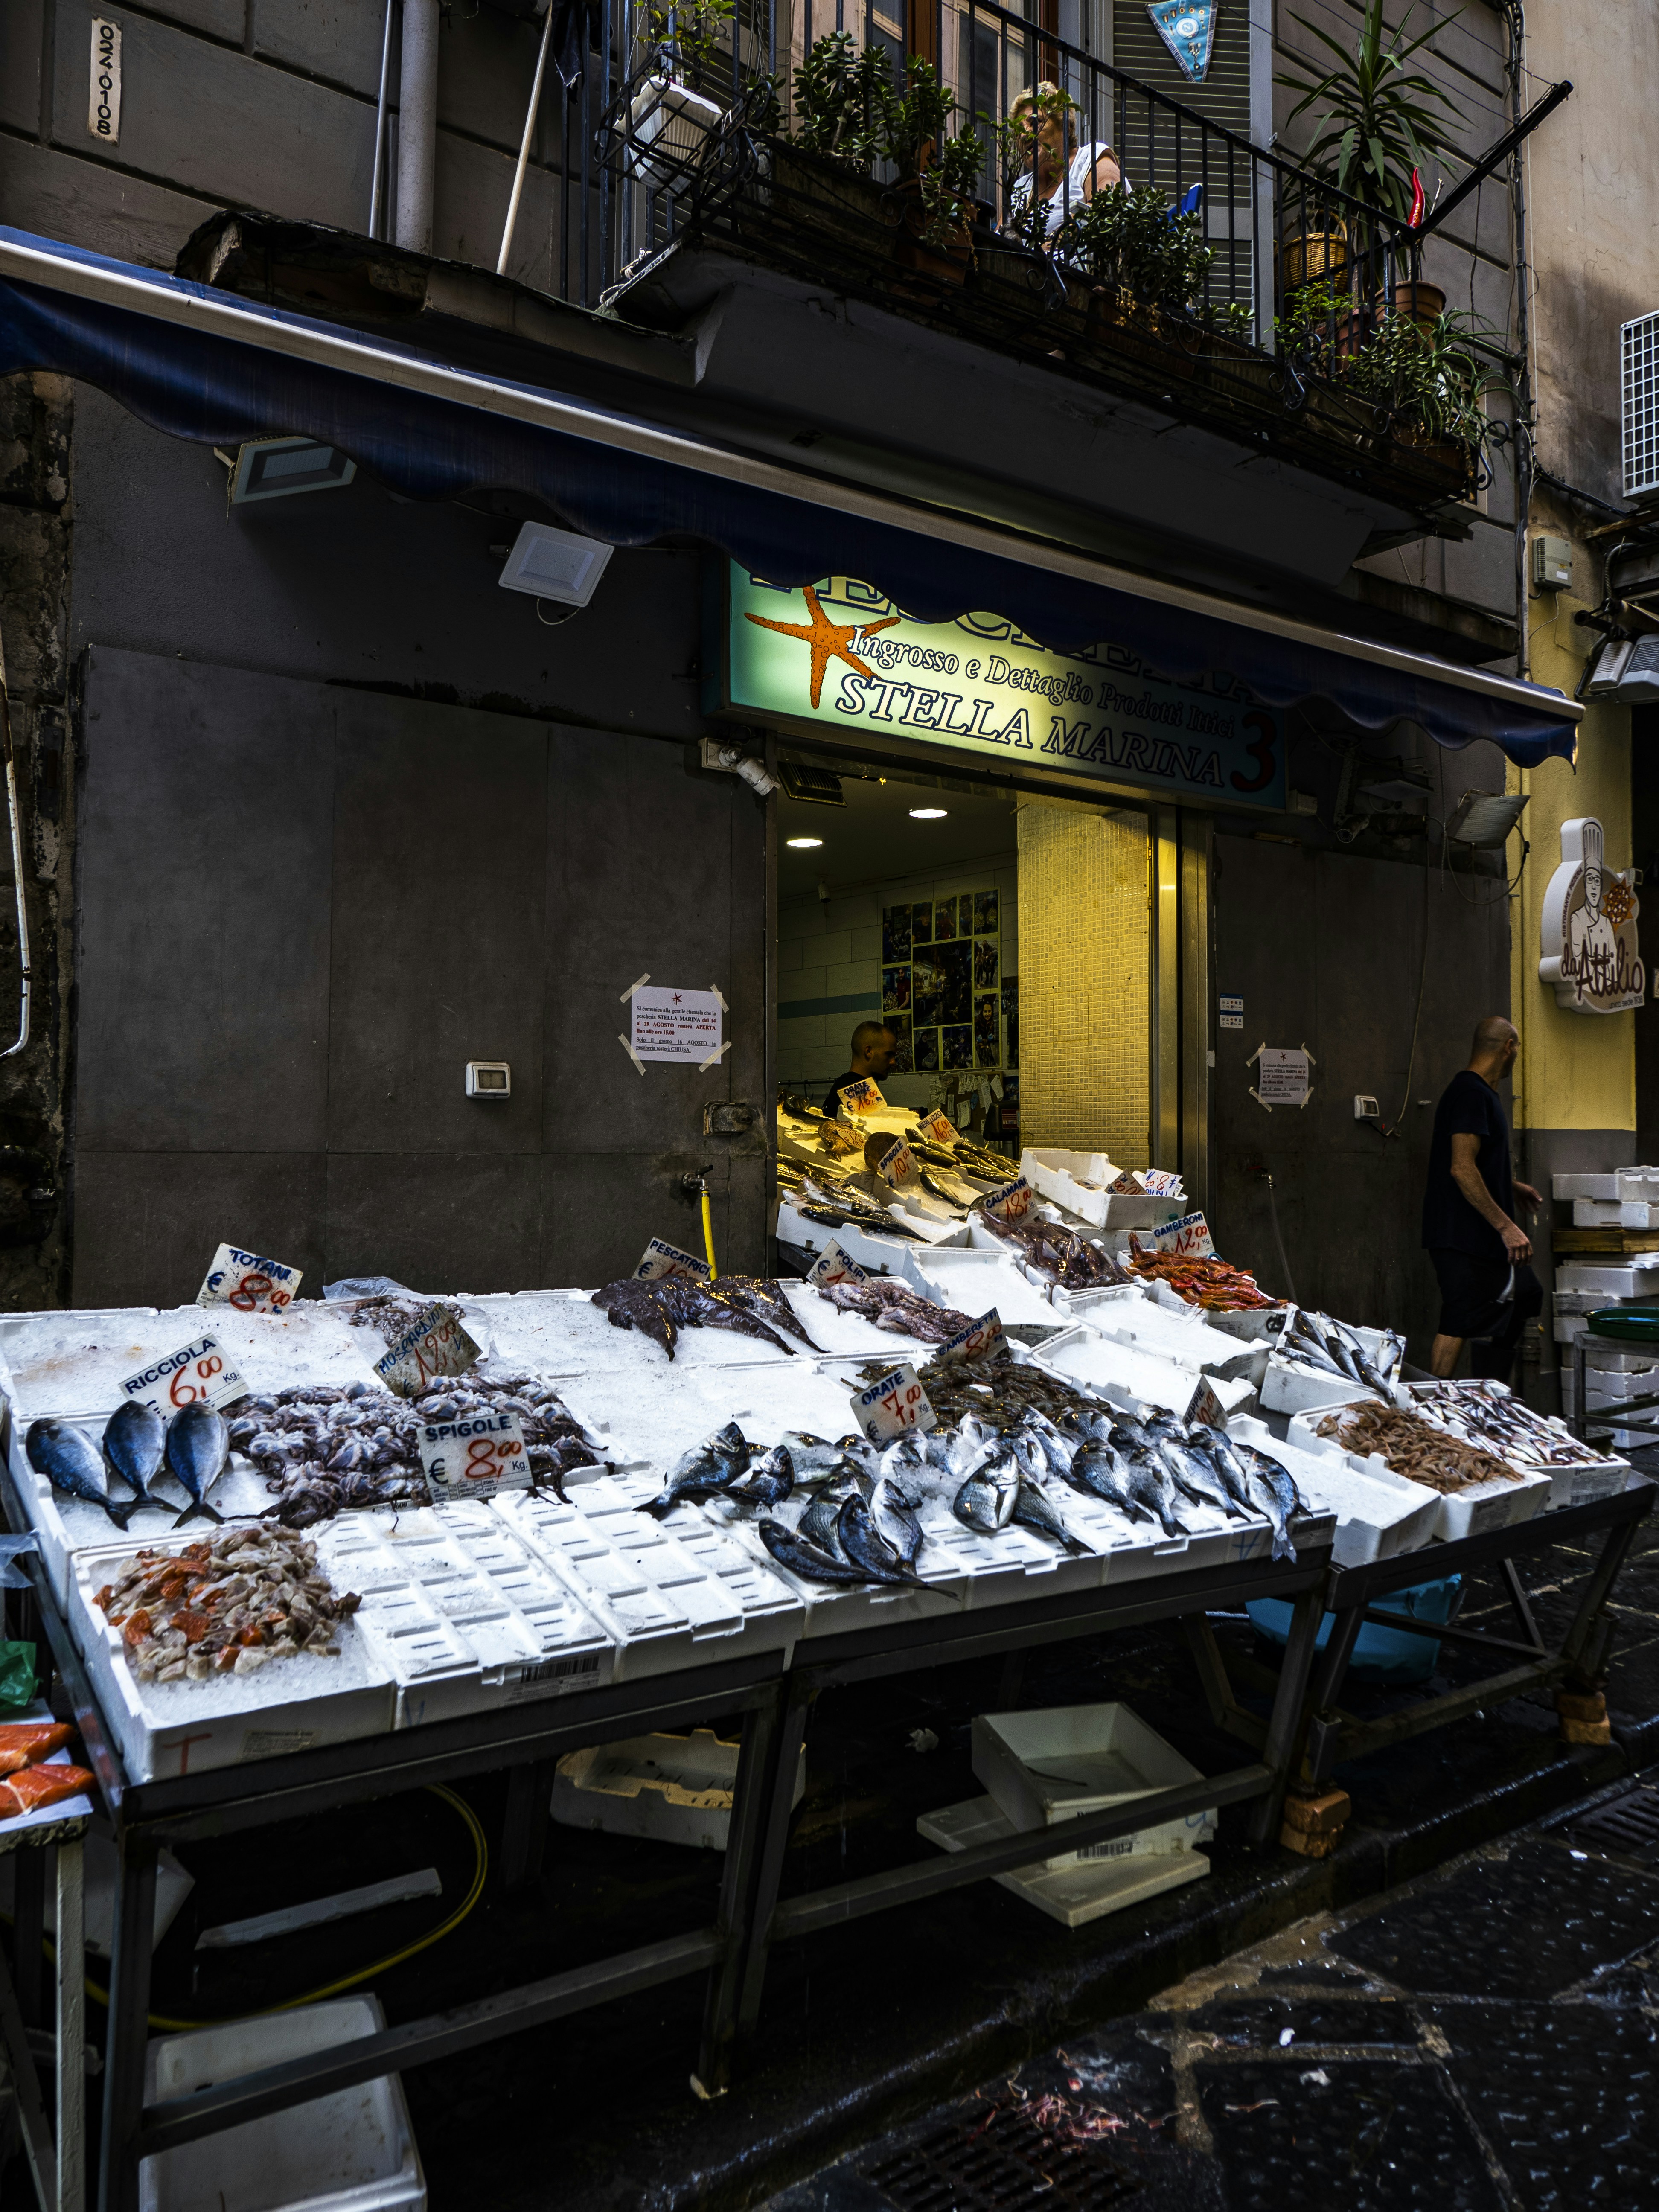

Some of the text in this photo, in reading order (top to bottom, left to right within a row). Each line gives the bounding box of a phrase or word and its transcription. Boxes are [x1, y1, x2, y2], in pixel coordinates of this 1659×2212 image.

[848, 625, 1234, 739] Ingrosso e Dettaglio Prodotti Ittici
[835, 673, 1276, 792] STELLA MARINA 3
[1562, 891, 1571, 937] RISTORANTE
[1576, 937, 1643, 1001] Attilio
[844, 1081, 867, 1094] ORATE
[917, 1111, 942, 1130] MERLUZZO
[880, 1141, 903, 1170] SPIGOLE
[986, 1177, 1027, 1208] CALAMARI
[1154, 1213, 1203, 1237] GAMBERONI
[229, 1248, 291, 1280] TOTANI
[650, 1240, 710, 1275] PESCATRICI
[836, 1249, 866, 1282] POLIPI
[939, 1310, 998, 1356] GAMBERETTI
[124, 1339, 216, 1394] RICCIOLA
[222, 1371, 239, 1382] Kg.
[862, 1371, 905, 1405] ORATE
[1185, 1385, 1205, 1428] SEPPIE
[425, 1415, 512, 1441] SPIGOLE
[429, 1458, 449, 1485] €
[512, 1460, 528, 1471] Kg.
